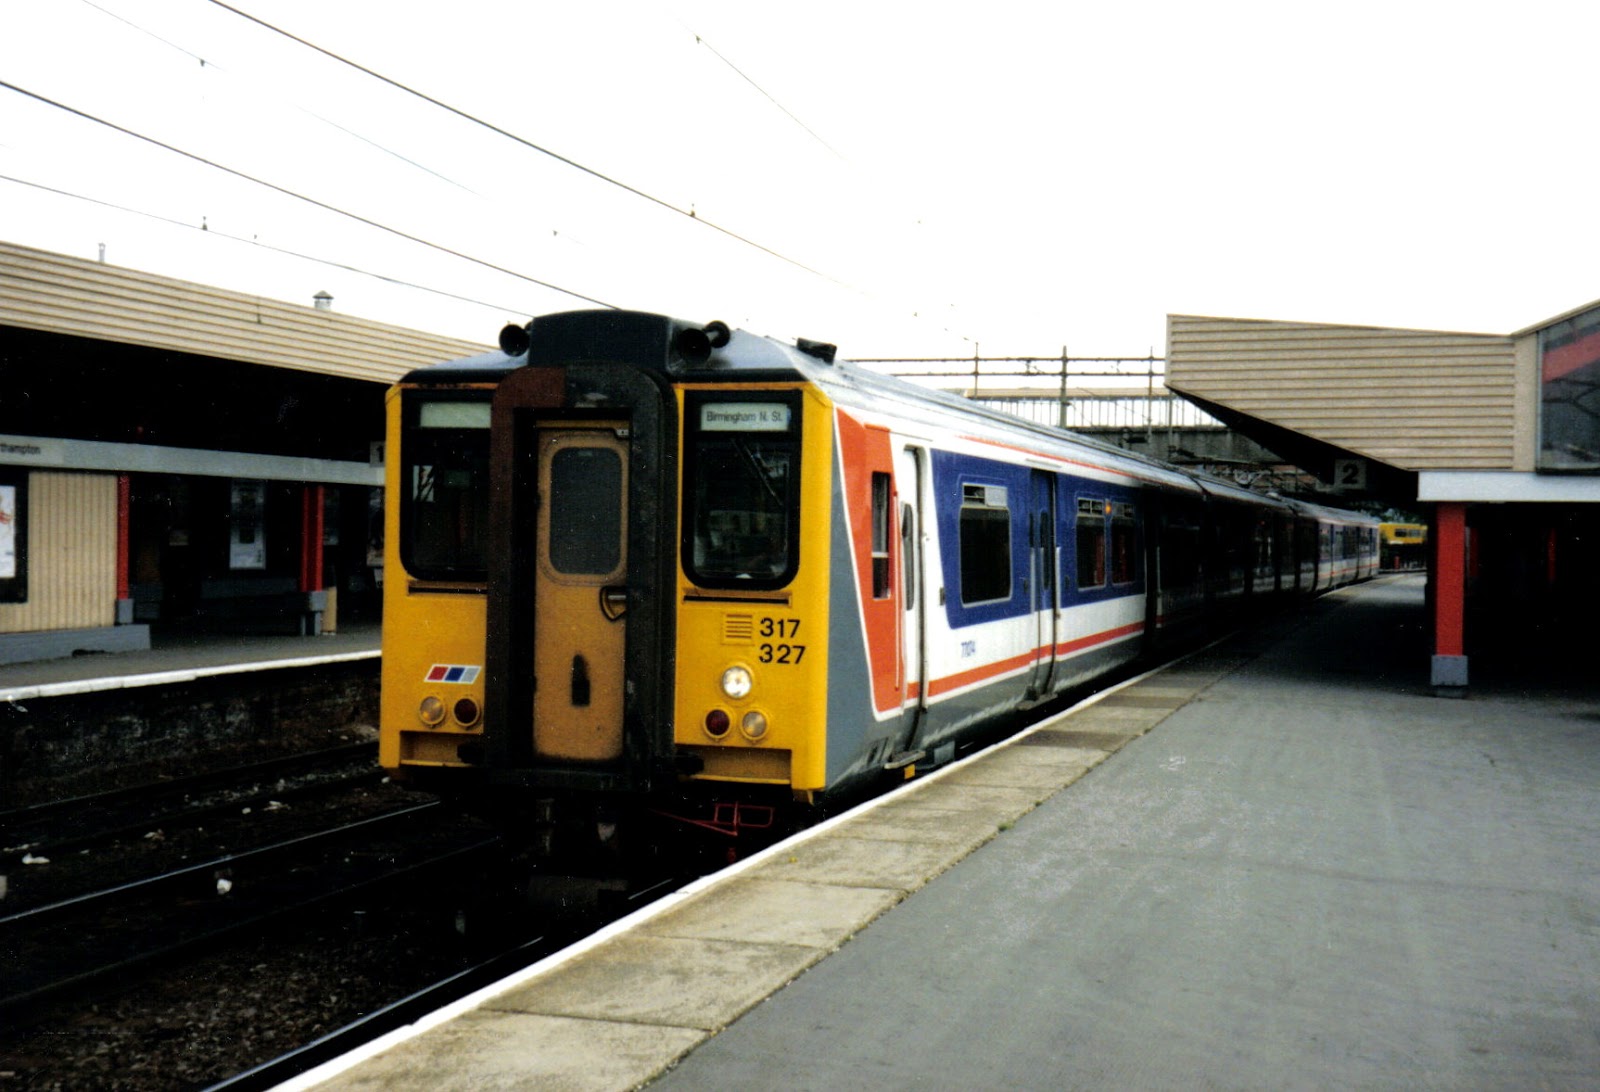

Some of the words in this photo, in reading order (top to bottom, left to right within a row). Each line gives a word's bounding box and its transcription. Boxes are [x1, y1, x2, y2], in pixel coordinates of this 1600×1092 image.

[706, 410, 757, 424] Birmingham
[1341, 463, 1359, 484] 2
[759, 617, 801, 638] 317
[758, 643, 806, 665] 327
